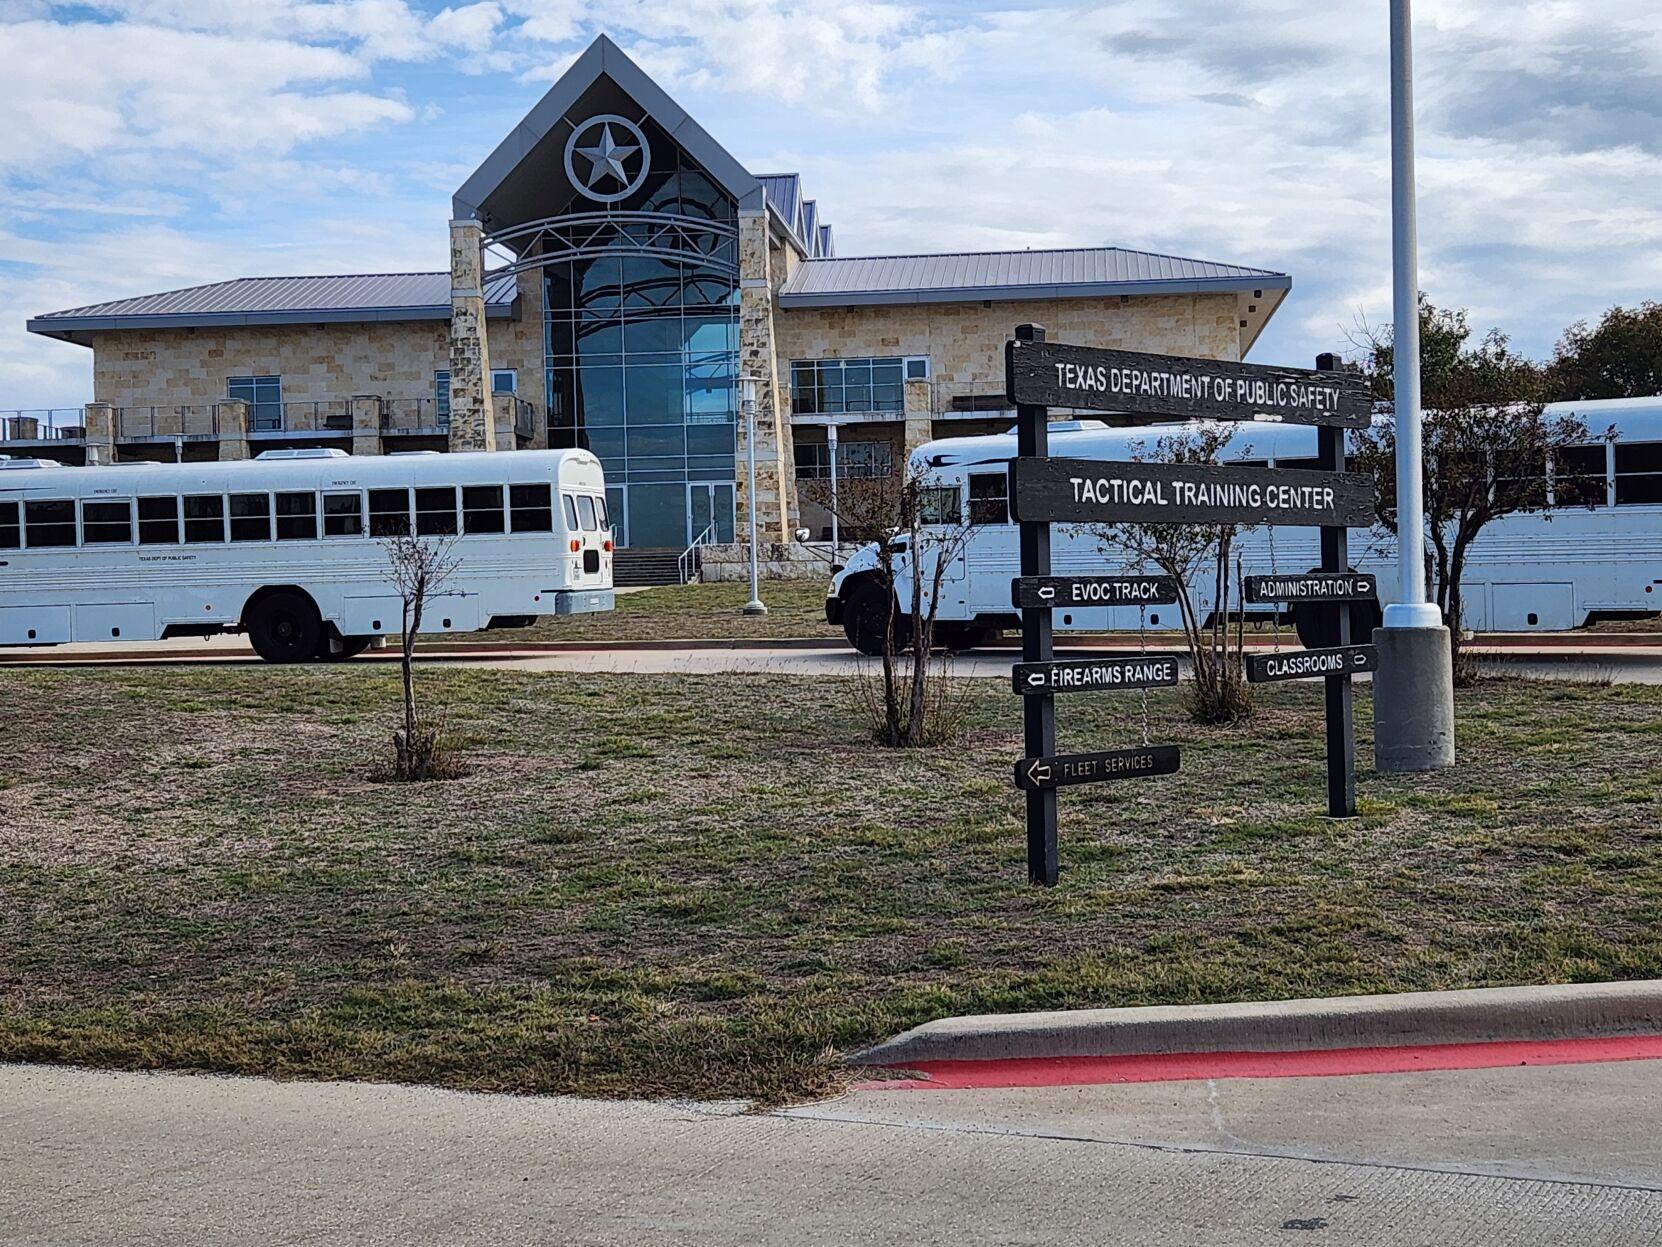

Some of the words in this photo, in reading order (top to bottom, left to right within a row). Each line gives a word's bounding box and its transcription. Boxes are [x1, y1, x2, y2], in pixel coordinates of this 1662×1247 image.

[1054, 363, 1107, 392] TEXAS
[1111, 368, 1211, 399] DEPARTMENT
[1214, 377, 1234, 402] OF
[1237, 379, 1288, 406] PUBLIC
[1290, 385, 1341, 411] SAFETY
[1069, 477, 1169, 506] TACTICAL
[1171, 480, 1262, 508] TRAINING
[1266, 484, 1335, 510] CENTER
[1072, 583, 1111, 601] EVOC
[1112, 582, 1159, 600] TRACK
[1259, 580, 1354, 597] ADMINISTRATION
[1051, 666, 1122, 687] FIREARMS
[1125, 663, 1172, 683] RANGE
[1266, 653, 1343, 676] CLASSROOMS
[1063, 760, 1098, 778] FLEET
[1105, 754, 1154, 773] SERVICES
